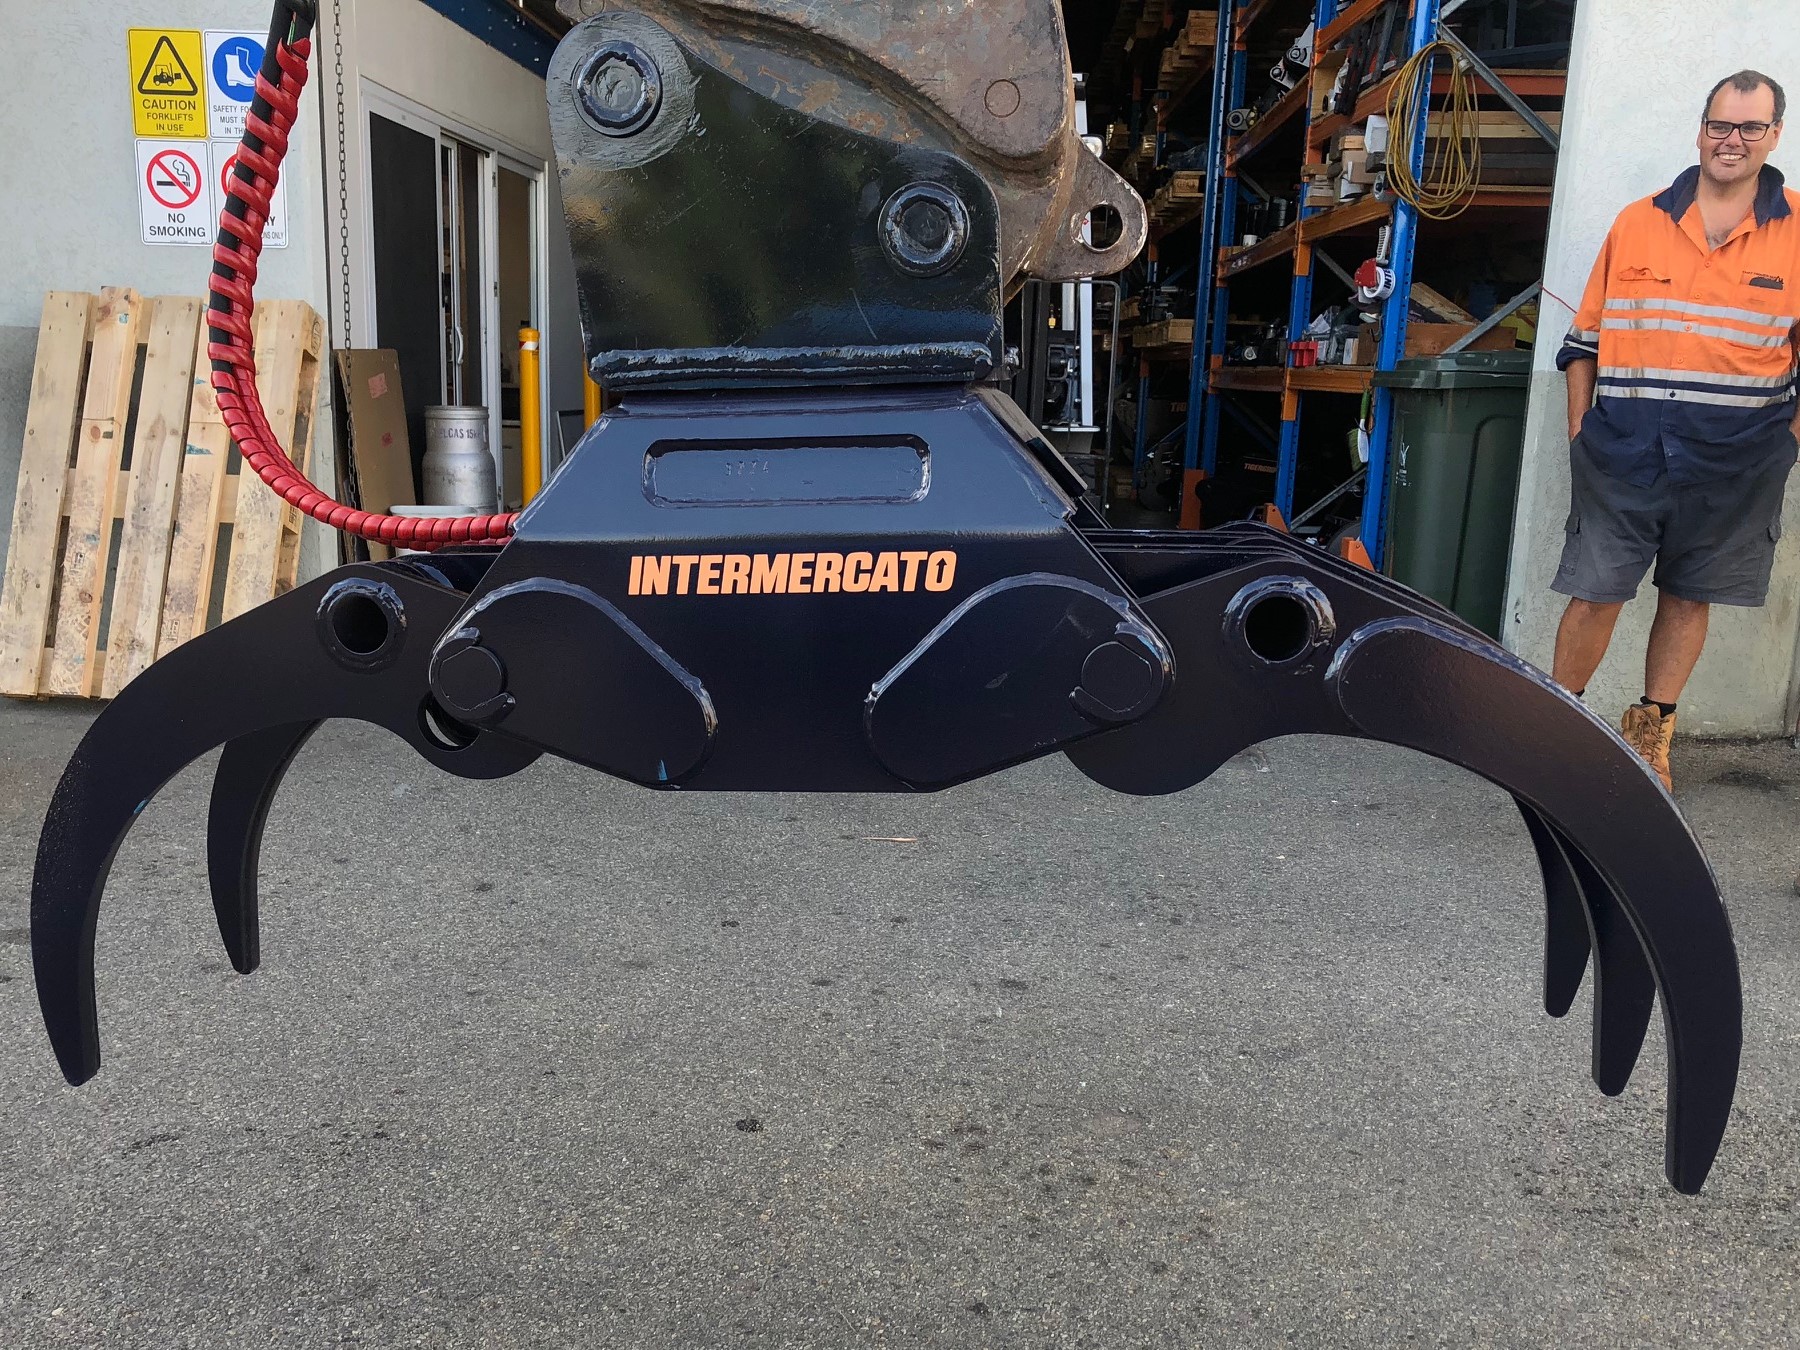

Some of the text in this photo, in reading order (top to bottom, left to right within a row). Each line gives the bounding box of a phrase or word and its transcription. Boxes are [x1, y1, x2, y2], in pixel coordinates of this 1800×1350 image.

[142, 98, 196, 110] CAUTION
[213, 104, 237, 112] SAFETY
[146, 112, 194, 121] FORKLIFTS
[156, 123, 184, 131] IN USE
[168, 213, 185, 223] NO
[149, 225, 206, 237] SMOKING
[628, 551, 957, 596] INTERMERCATO
